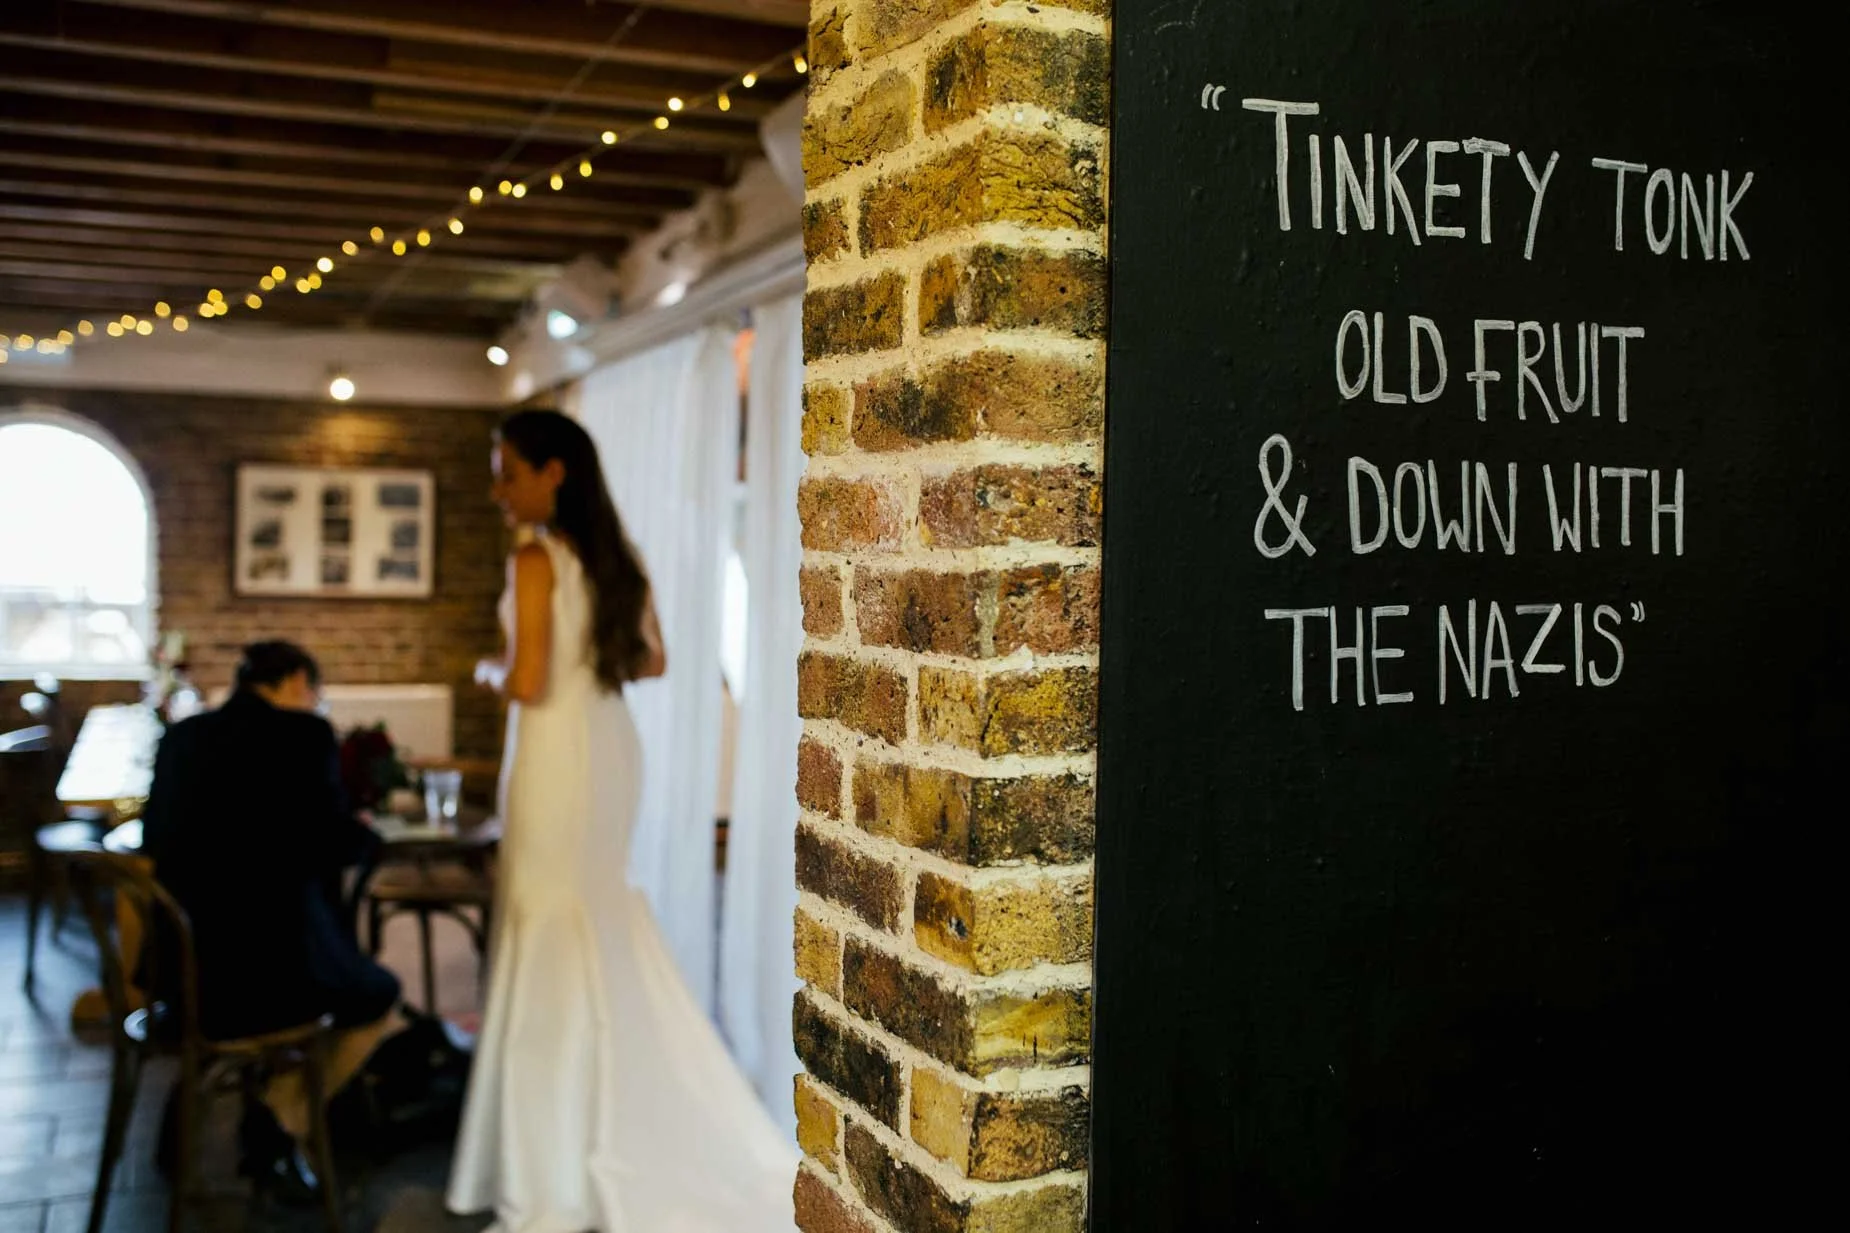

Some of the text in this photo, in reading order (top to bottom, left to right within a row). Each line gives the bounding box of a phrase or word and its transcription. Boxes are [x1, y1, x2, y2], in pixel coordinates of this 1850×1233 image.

[1591, 157, 1754, 261] TONK
[1335, 309, 1645, 424] OLD FRUIT
[1253, 433, 1684, 559] & DOWN WITH
[1264, 598, 1646, 712] THE NAZIS”
